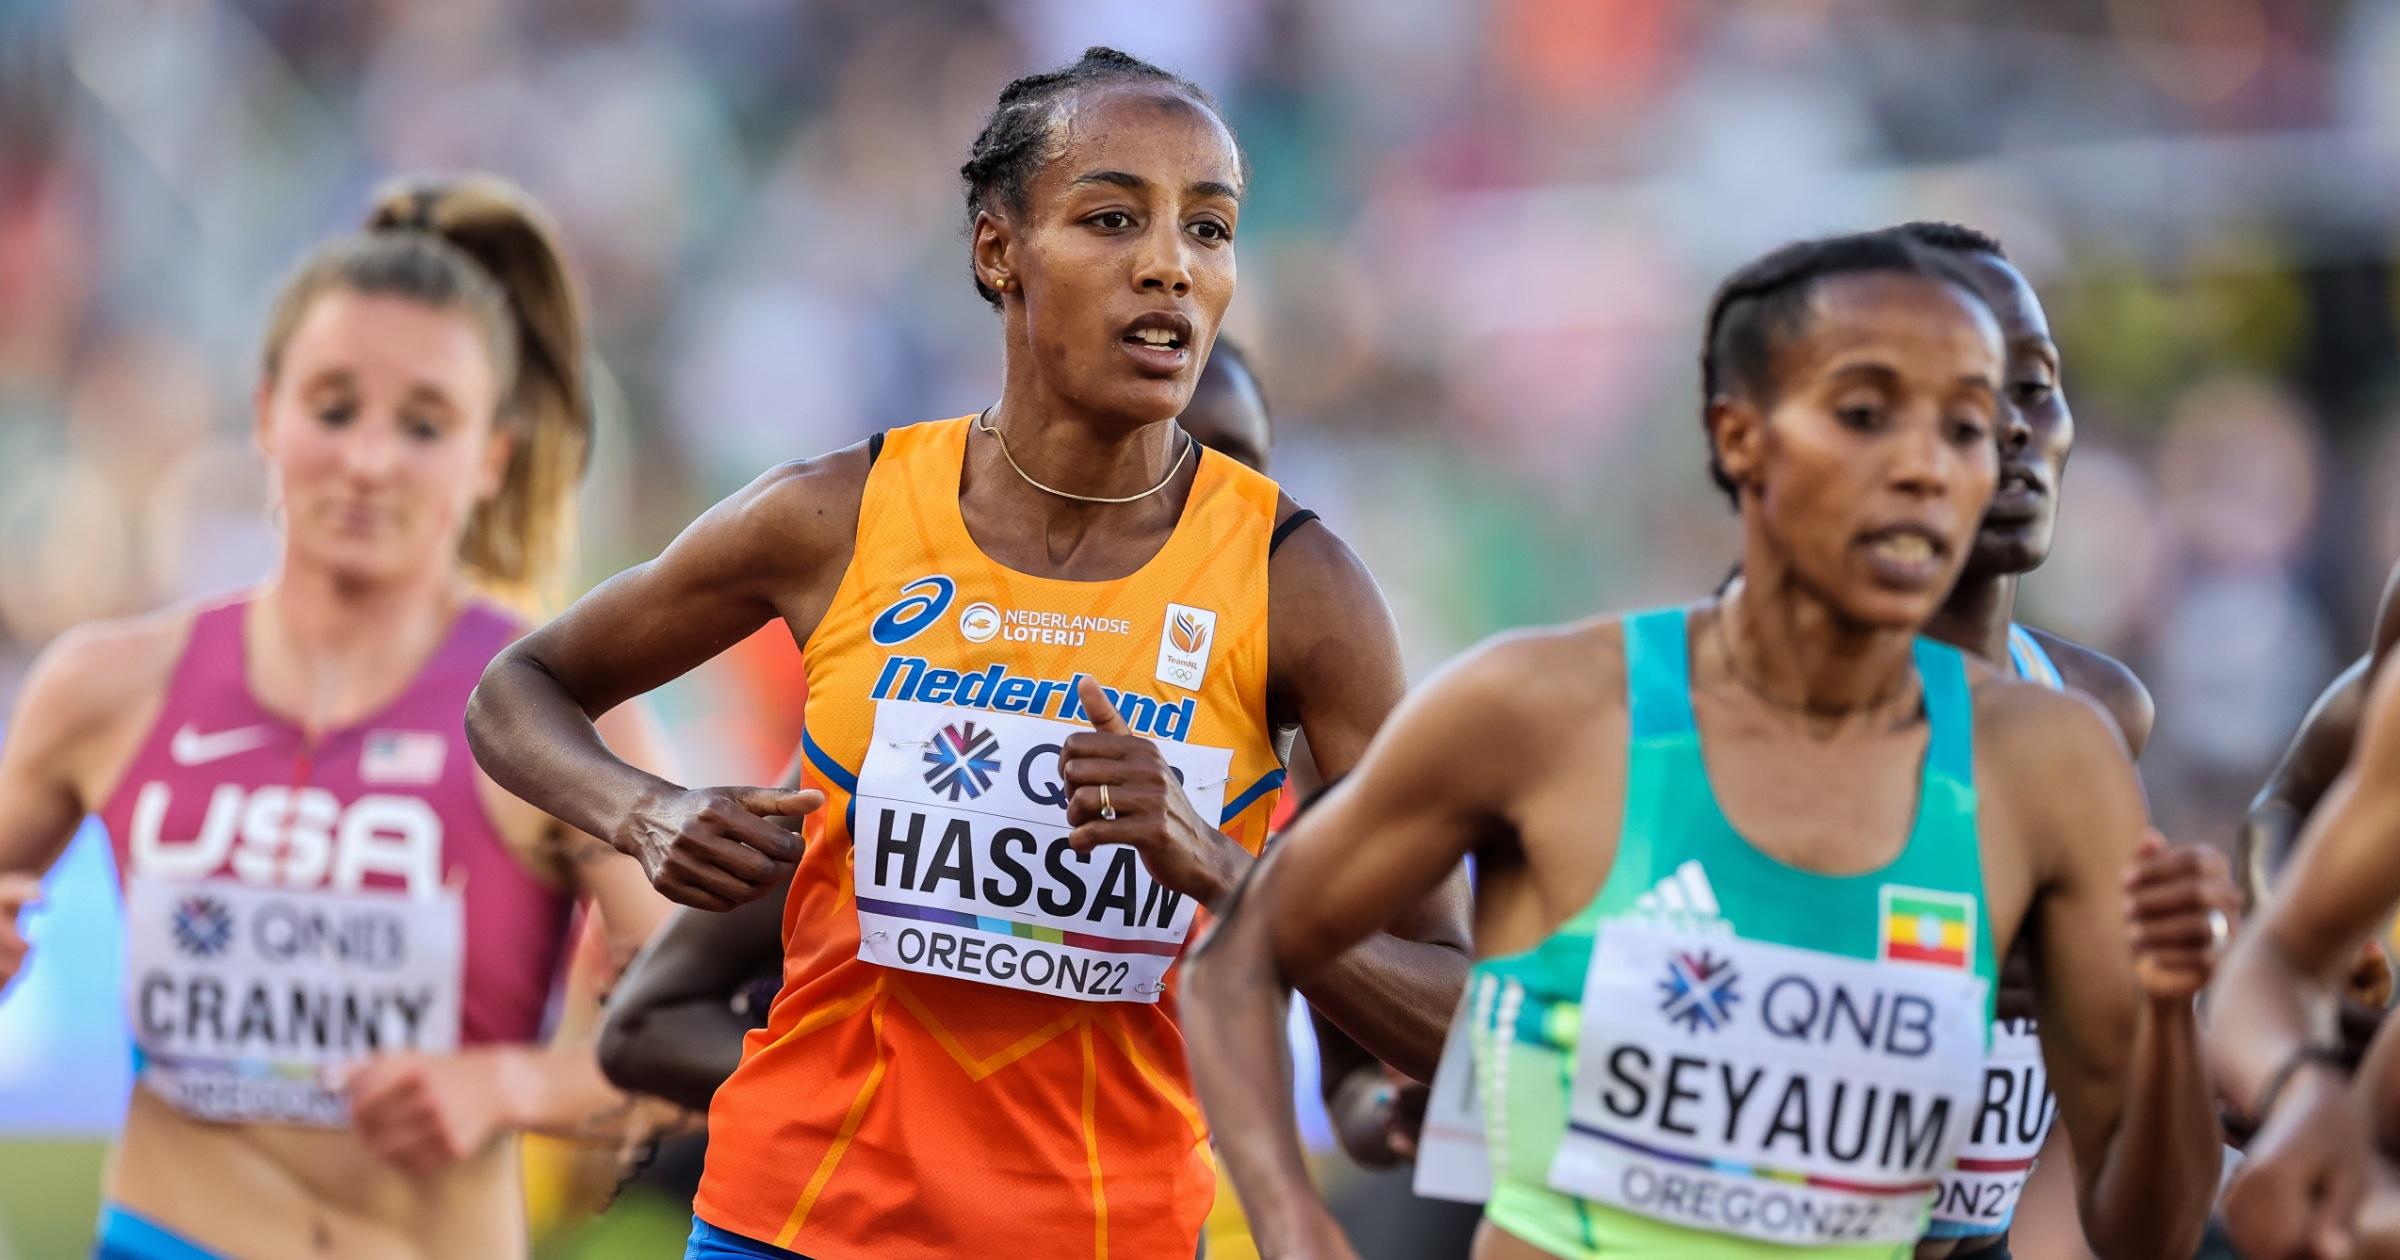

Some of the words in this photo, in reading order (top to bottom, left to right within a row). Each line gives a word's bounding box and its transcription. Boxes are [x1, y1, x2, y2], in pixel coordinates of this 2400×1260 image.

[1003, 626, 1086, 647] LOTERIJ
[1004, 609, 1130, 635] NEDERLANDSE
[1166, 654, 1198, 670] TeamNL
[869, 655, 1198, 743] Nederlnd
[129, 781, 443, 896] USA
[873, 808, 1182, 930] HASSAN
[252, 905, 405, 963] QNB
[897, 928, 1129, 996] OREGON22
[139, 969, 432, 1050] CRANNY
[1760, 975, 1934, 1057] QNB
[1602, 1045, 1952, 1172] SEYAUM
